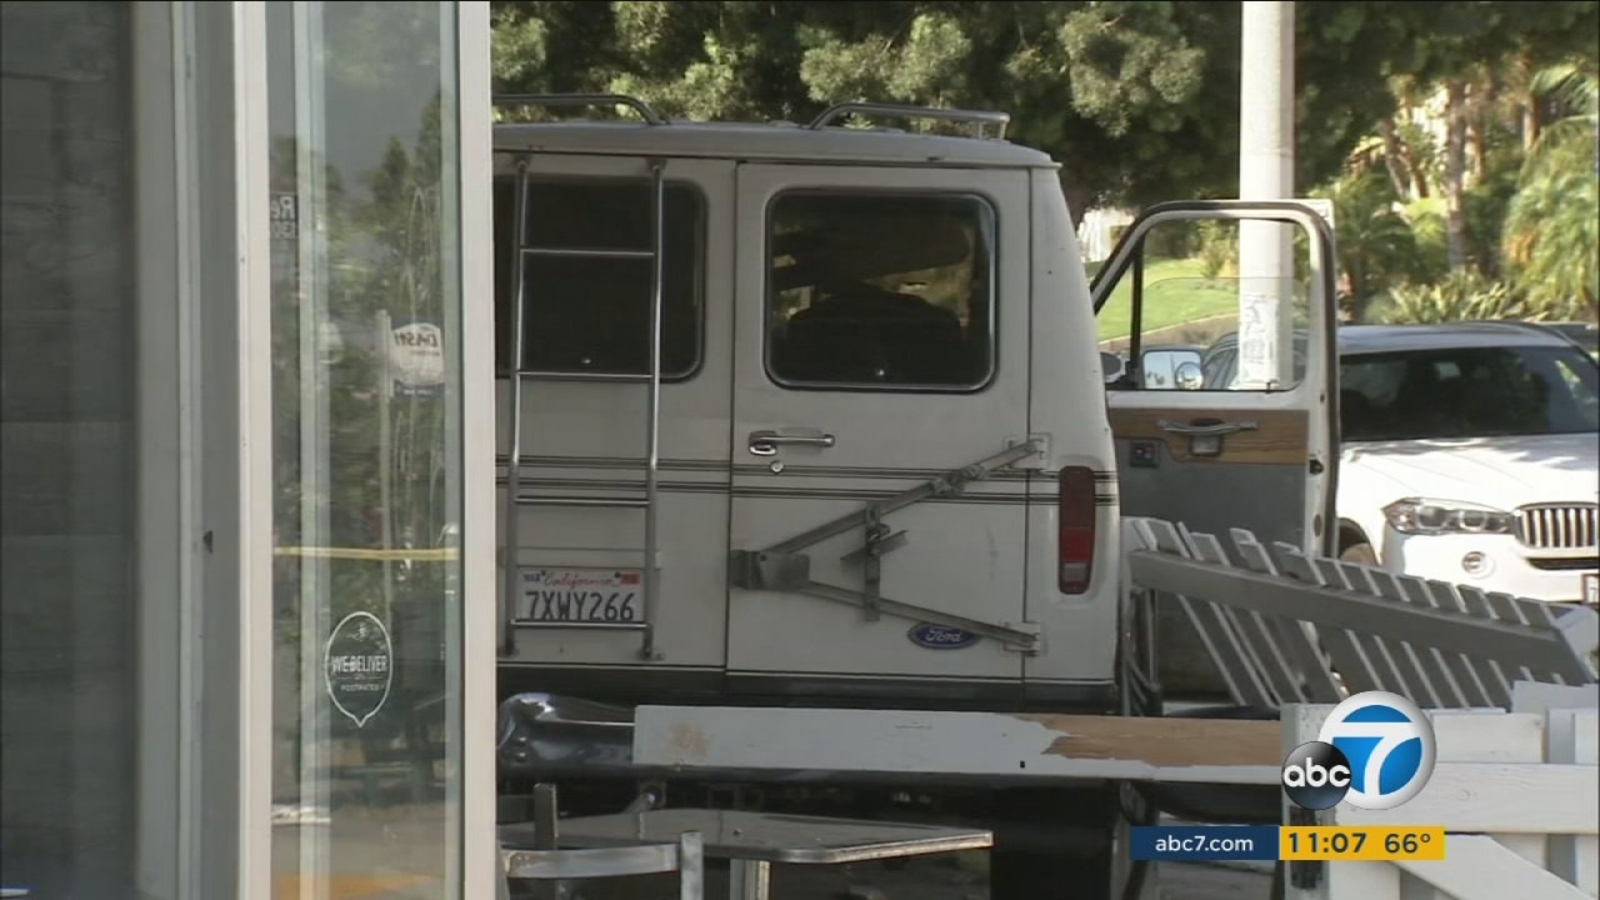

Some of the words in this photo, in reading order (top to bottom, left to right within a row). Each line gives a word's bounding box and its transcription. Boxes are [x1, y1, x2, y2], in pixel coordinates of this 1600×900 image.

[543, 571, 619, 589] California
[525, 591, 635, 620] 7XWY266
[924, 629, 961, 642] Ford
[331, 655, 349, 672] WE
[350, 655, 388, 672] DELIVER
